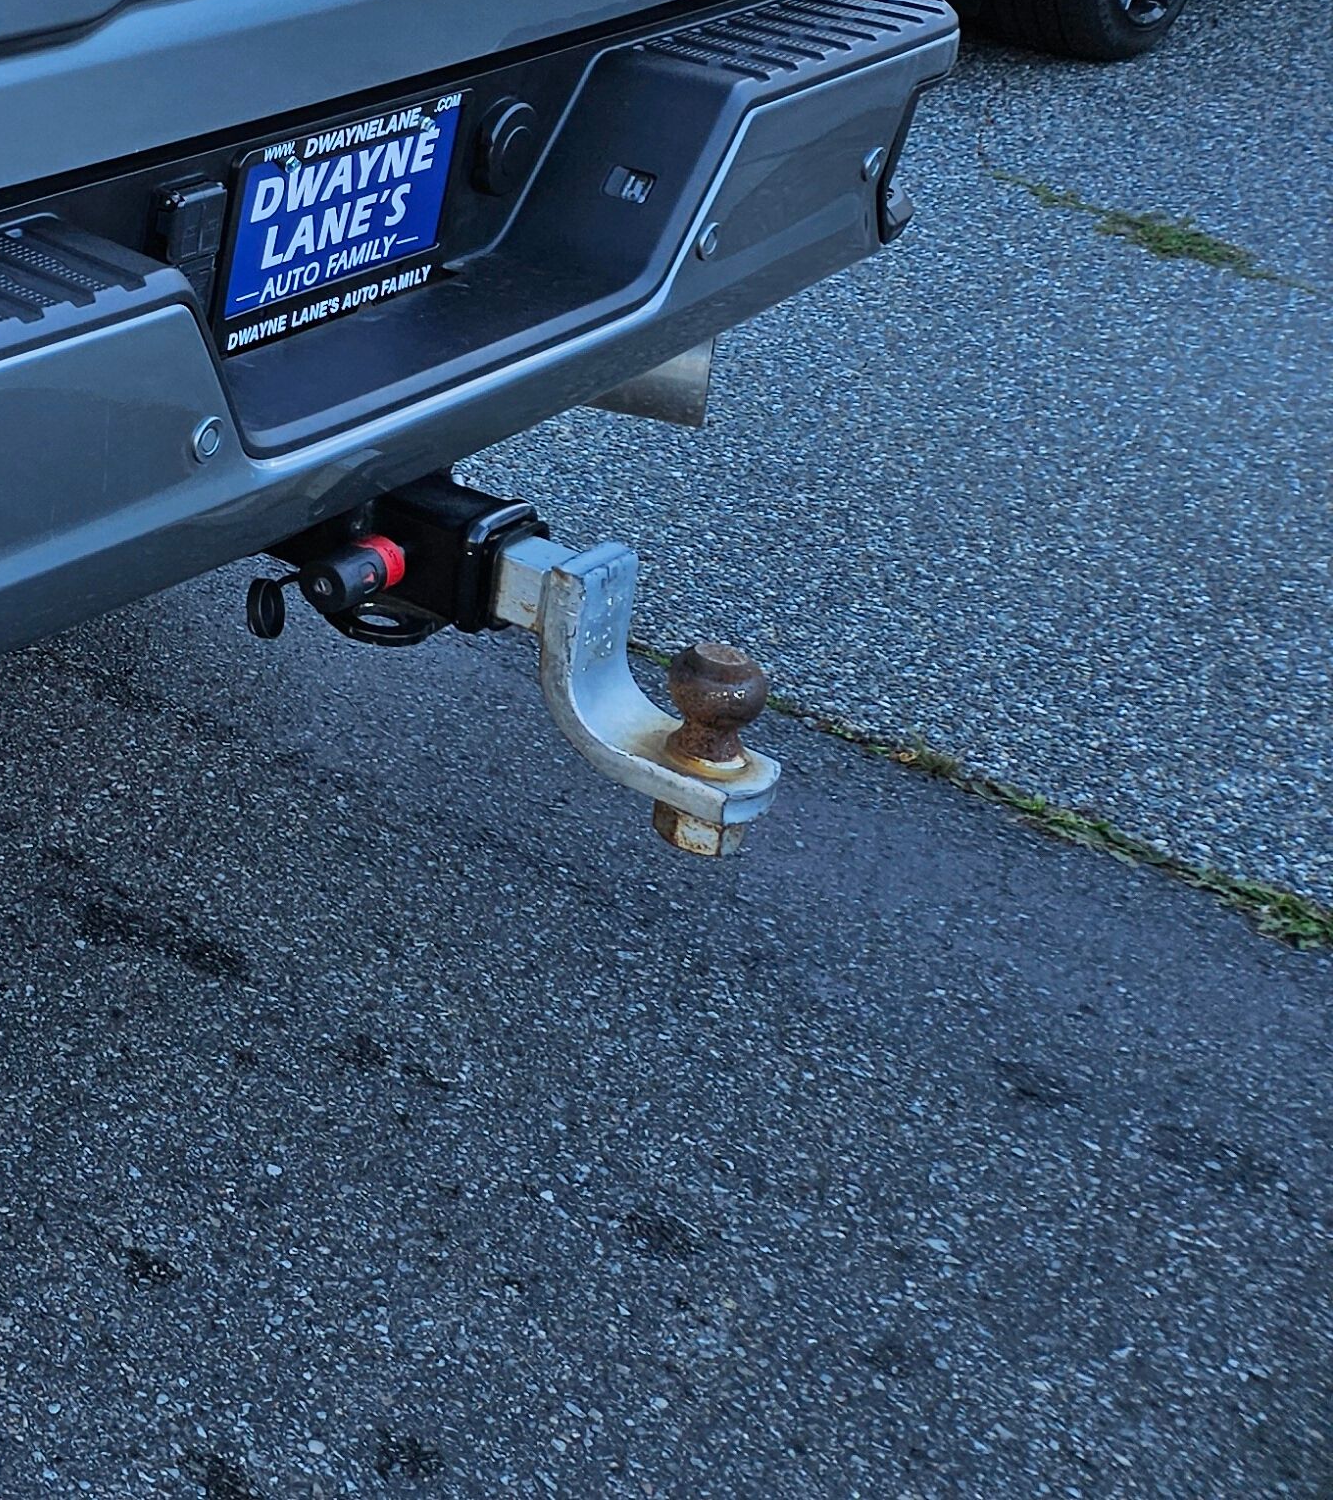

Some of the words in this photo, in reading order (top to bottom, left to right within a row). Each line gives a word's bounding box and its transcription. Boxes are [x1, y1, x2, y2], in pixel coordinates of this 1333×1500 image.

[250, 127, 440, 223] DWAYNE
[303, 107, 422, 158] DWAYNELANE
[259, 261, 321, 303] AUTO
[325, 233, 397, 278] FAMILY
[261, 183, 412, 270] LANE'S
[227, 314, 287, 351] DWAYNE
[291, 296, 340, 328] LANE'S
[342, 283, 379, 311] AUTO
[381, 264, 432, 297] FAMILY
